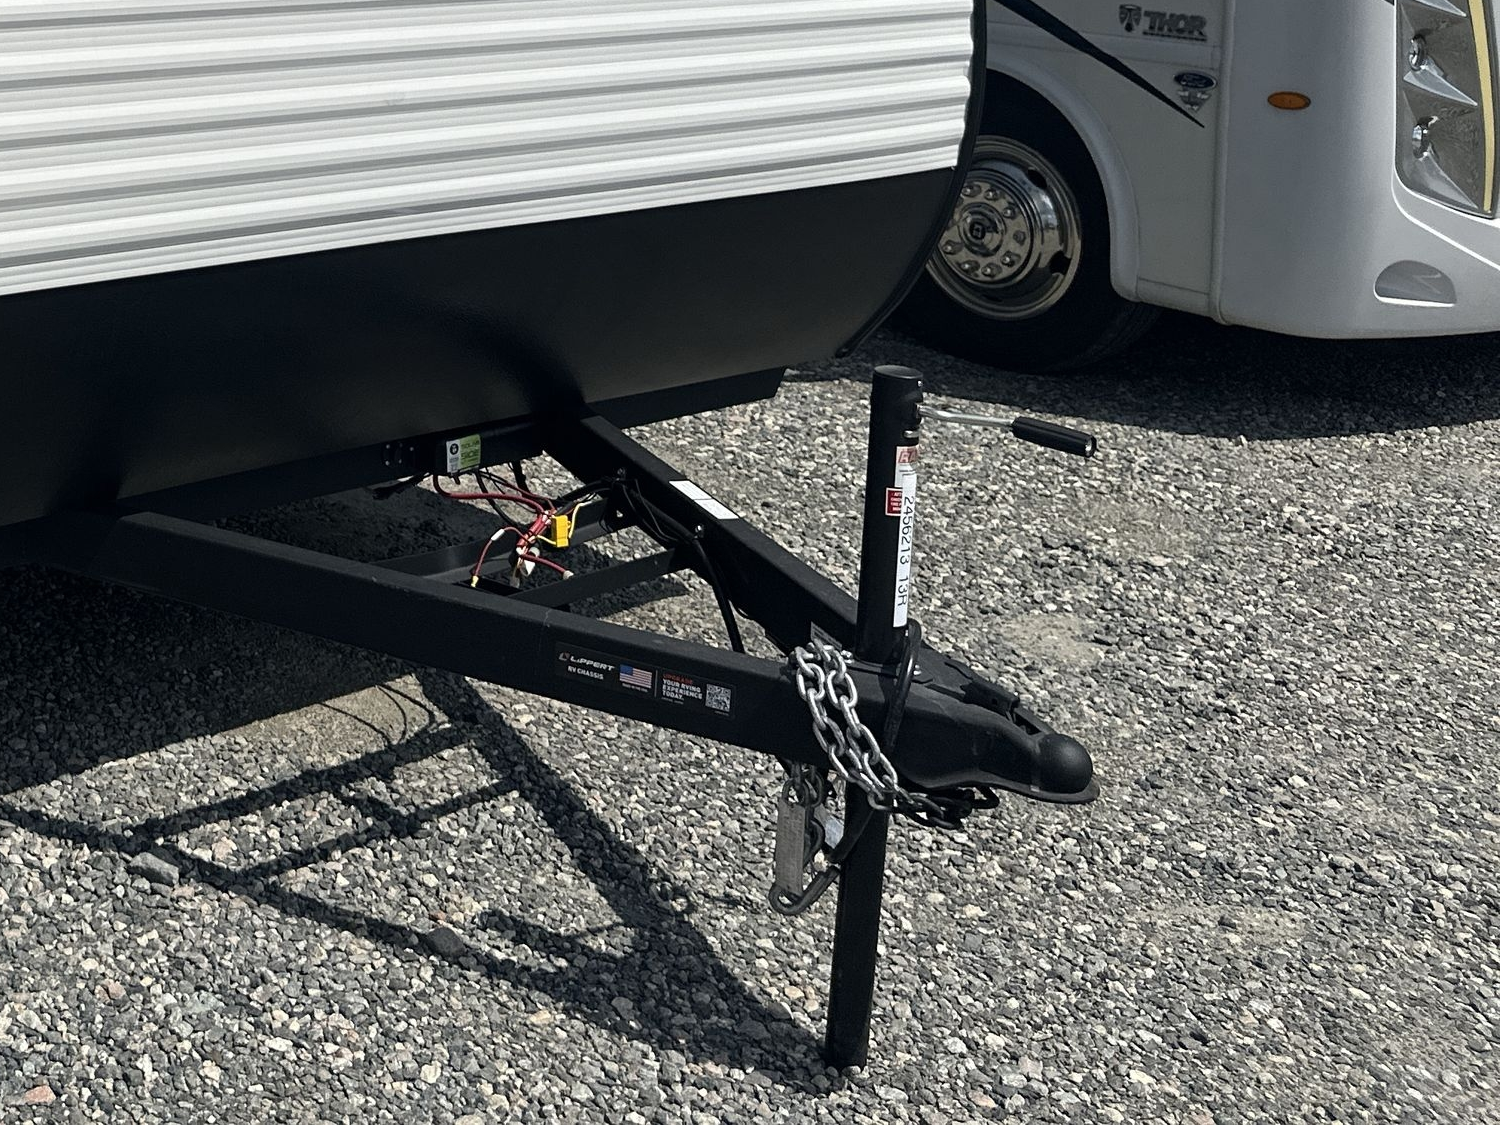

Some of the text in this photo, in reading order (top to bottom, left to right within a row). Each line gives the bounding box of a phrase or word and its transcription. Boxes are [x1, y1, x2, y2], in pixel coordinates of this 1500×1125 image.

[1143, 10, 1207, 36] THOR
[900, 495, 915, 565] 2456213
[570, 655, 615, 672] LIPPERT
[577, 667, 604, 680] CHASSIS
[662, 683, 703, 700] EXPERIENCE
[663, 678, 701, 693] YOUR RVING
